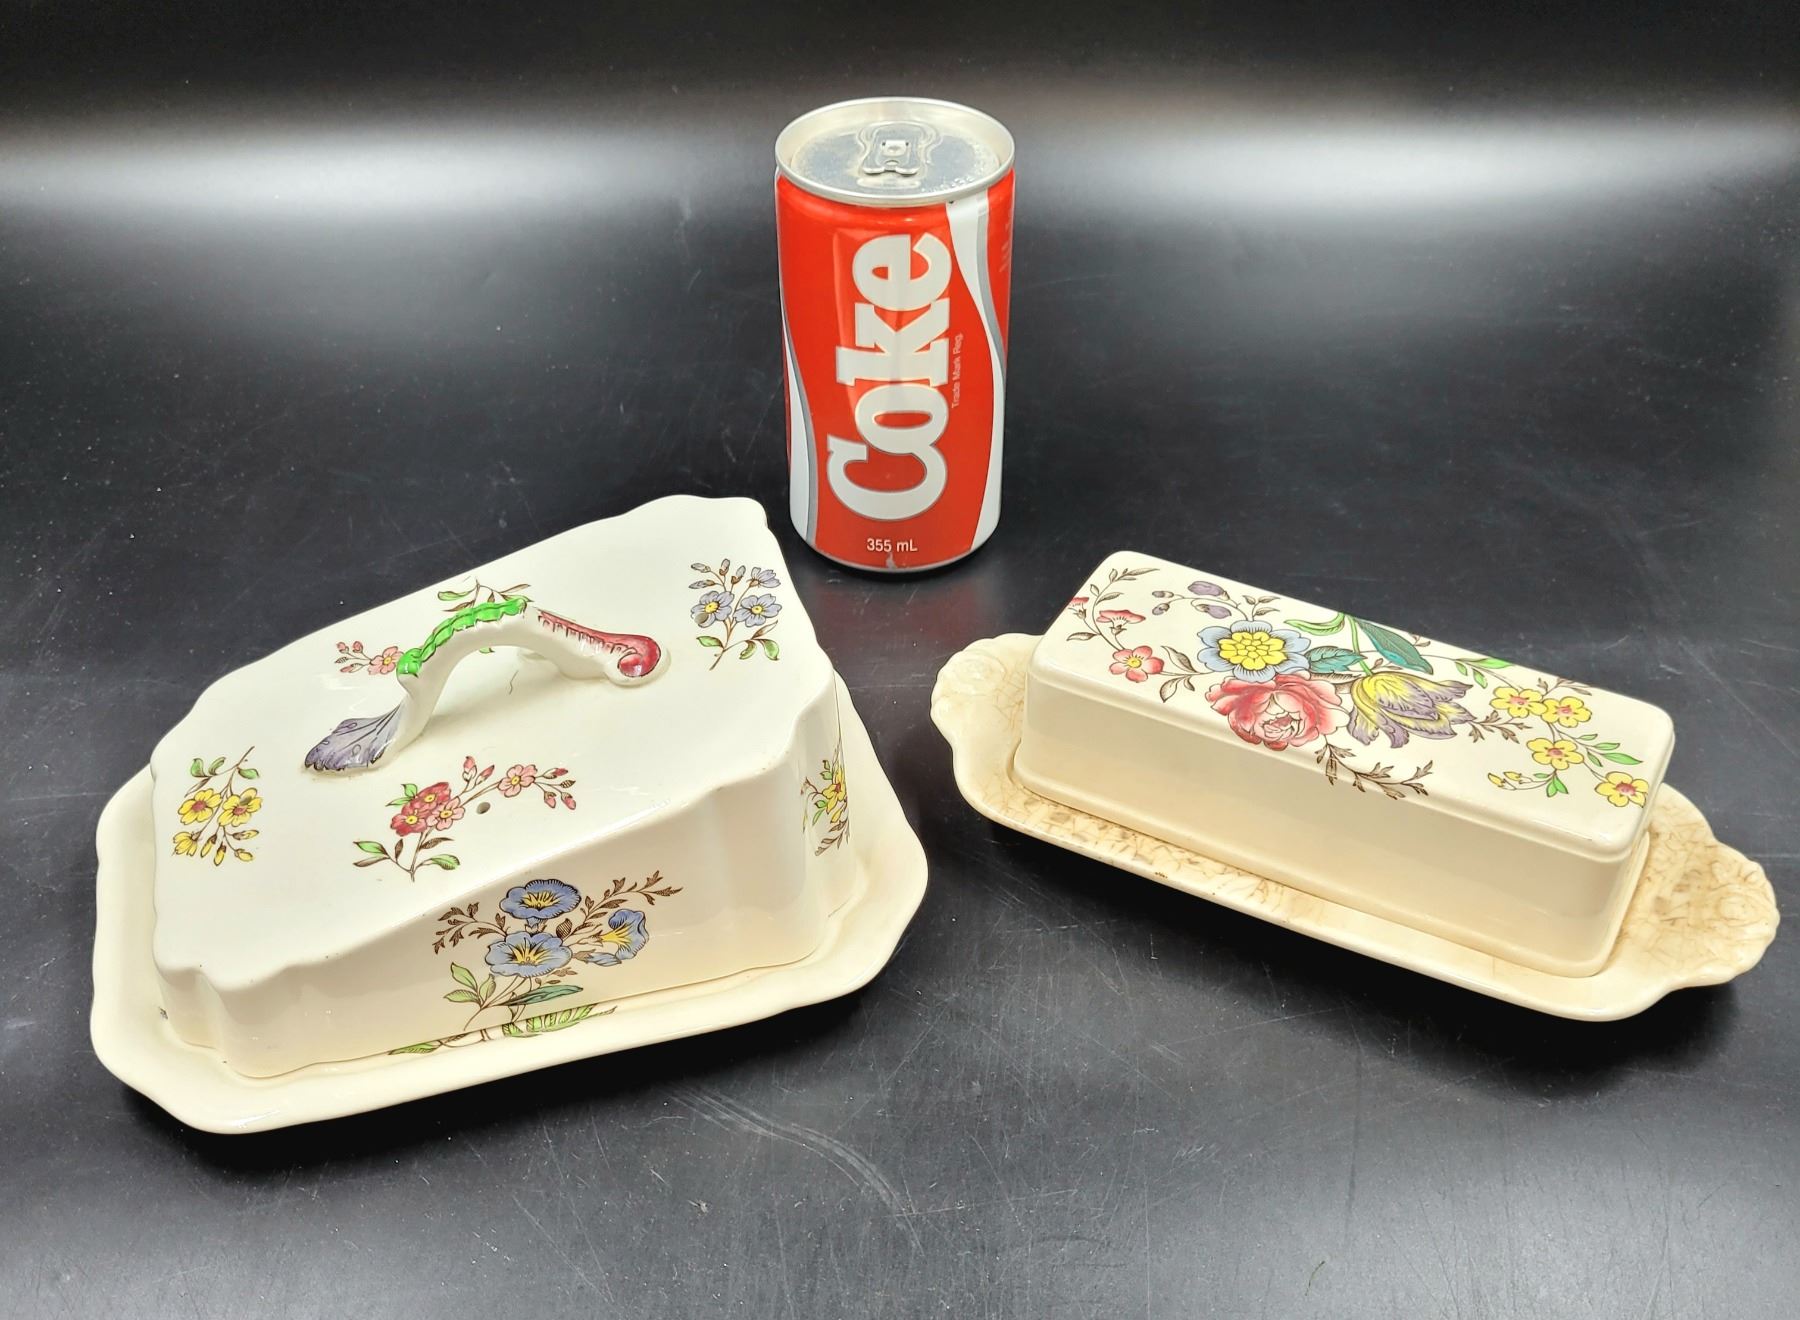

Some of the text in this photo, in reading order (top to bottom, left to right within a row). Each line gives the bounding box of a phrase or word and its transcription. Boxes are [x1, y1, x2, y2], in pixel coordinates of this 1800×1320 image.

[827, 234, 952, 521] Coke
[952, 356, 961, 381] Mark
[951, 381, 961, 409] Trade
[866, 538, 918, 552] 355 mL
